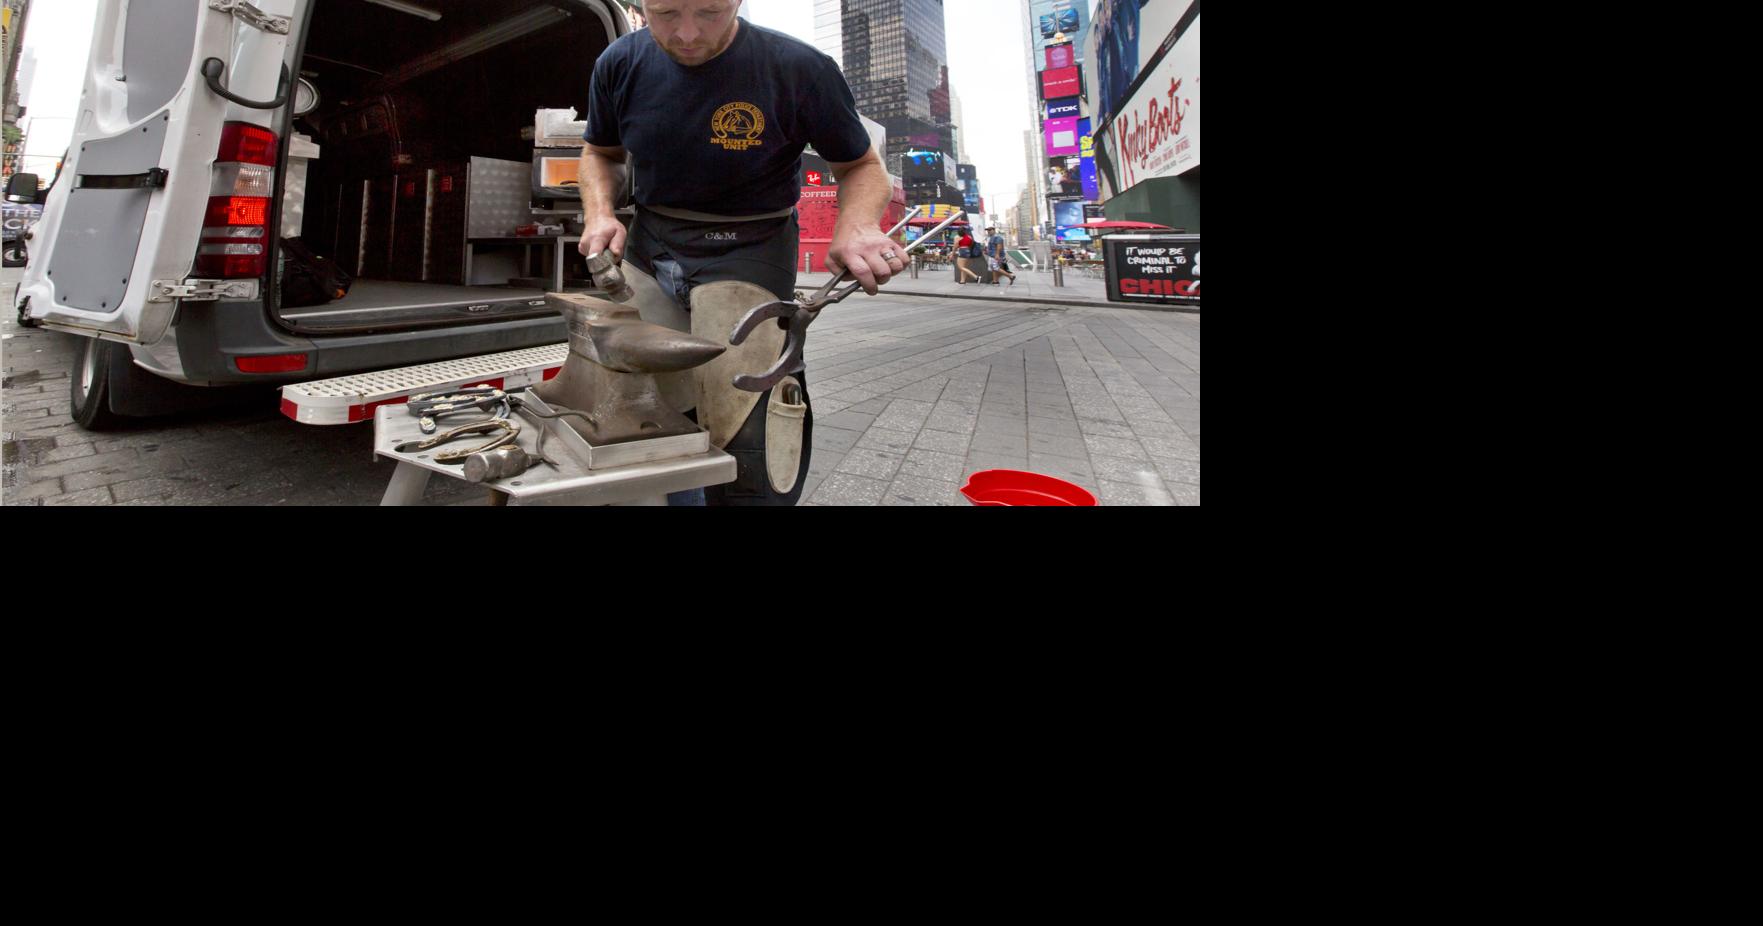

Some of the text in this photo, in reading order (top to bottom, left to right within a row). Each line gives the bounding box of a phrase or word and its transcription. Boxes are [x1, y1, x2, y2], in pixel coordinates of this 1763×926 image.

[1118, 110, 1149, 172] Kinky
[1148, 77, 1186, 153] Boots
[711, 137, 762, 145] MOUNTED
[705, 232, 736, 240] C&M
[1126, 246, 1185, 256] IT WOULD BE
[1127, 256, 1187, 265] CRIMINAL TO
[1142, 265, 1164, 274] MISS
[1120, 278, 1200, 296] CHIC
